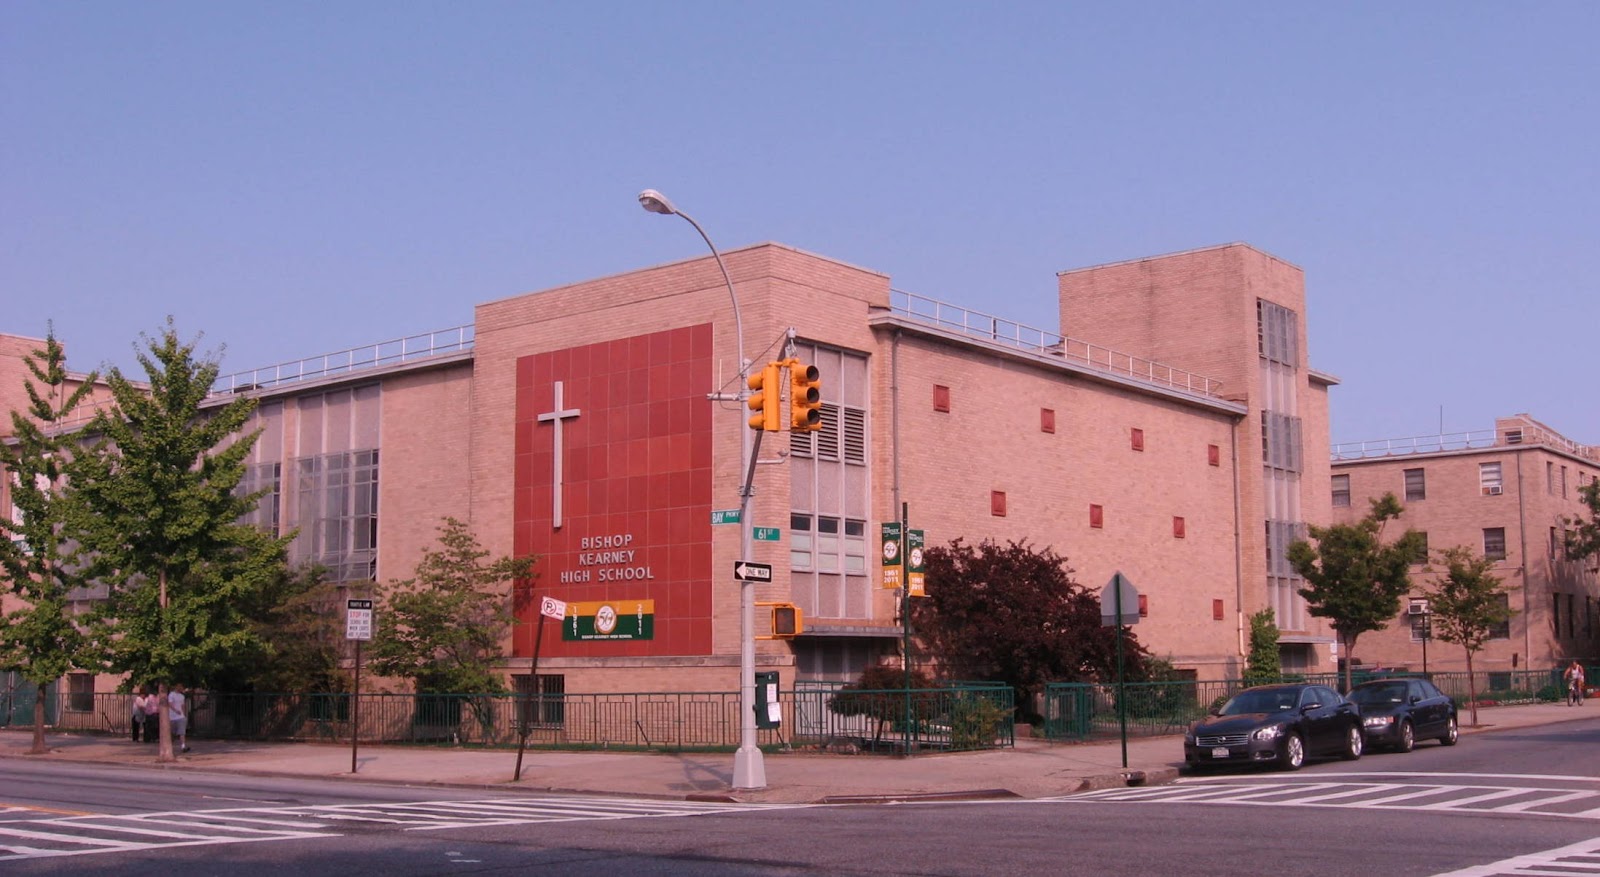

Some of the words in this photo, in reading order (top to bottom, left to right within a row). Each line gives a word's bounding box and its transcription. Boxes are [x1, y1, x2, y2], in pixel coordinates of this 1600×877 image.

[712, 512, 724, 524] BAY
[758, 529, 767, 539] 61
[581, 534, 633, 549] BISHOP
[579, 550, 635, 566] KEARNEY
[560, 570, 590, 583] HIGH
[598, 566, 655, 581] SCHOOL
[746, 568, 757, 577] ONE
[757, 569, 768, 577] WAY
